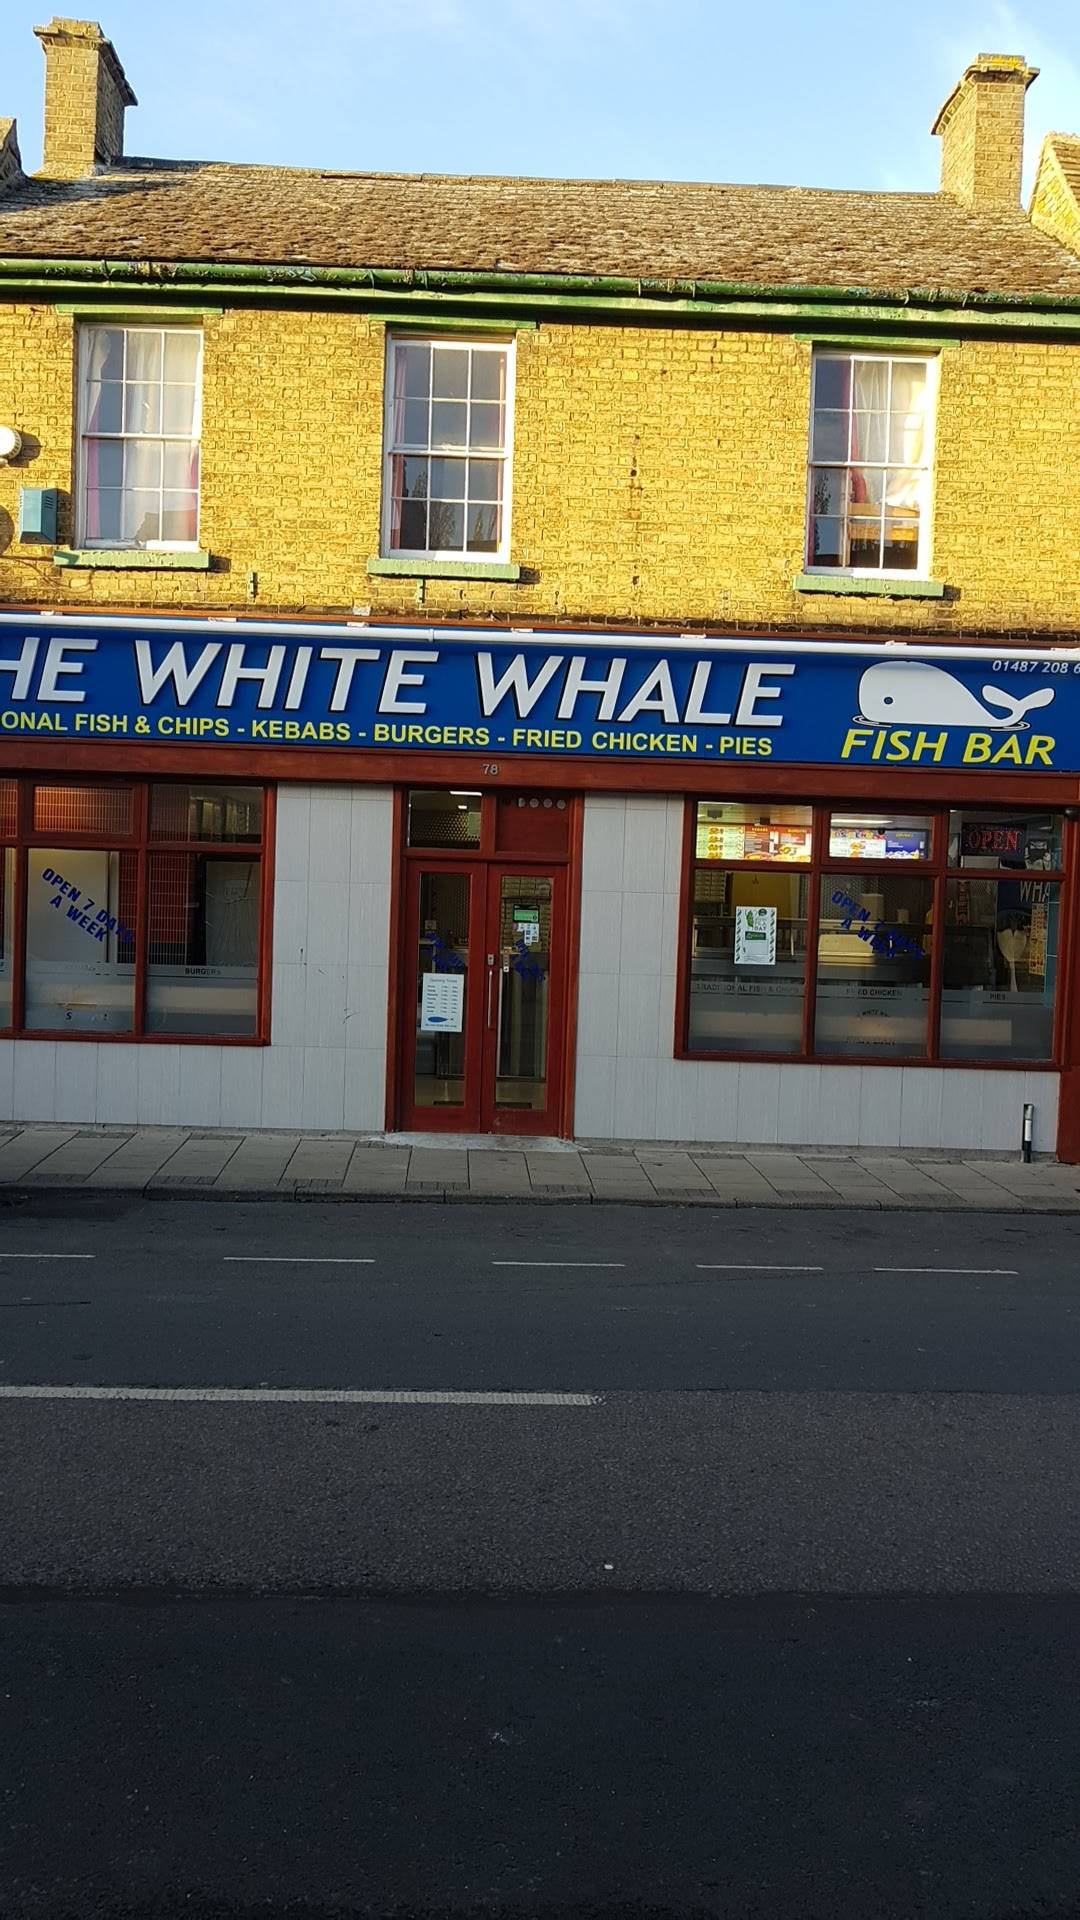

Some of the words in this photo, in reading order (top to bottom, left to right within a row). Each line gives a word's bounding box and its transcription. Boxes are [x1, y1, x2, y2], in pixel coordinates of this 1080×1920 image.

[135, 640, 439, 713] WHITE
[477, 652, 796, 726] WHALE
[992, 660, 1038, 673] 01487
[1041, 661, 1068, 673] 208
[75, 713, 128, 733] FISH
[134, 715, 151, 734] &
[158, 716, 229, 736] CHIPS
[252, 720, 350, 741] KEBABS
[374, 723, 490, 745] BURGERS
[512, 728, 582, 748] FRIED
[592, 731, 697, 752] CHICKEN
[719, 736, 773, 756] PIES
[840, 729, 949, 762] FISH
[962, 731, 1056, 765] BAR
[482, 764, 499, 775] 78
[968, 831, 1021, 850] OPEN
[41, 868, 81, 902] OPEN
[83, 898, 95, 911] 7
[50, 895, 63, 909] A
[66, 905, 107, 942] WEEK
